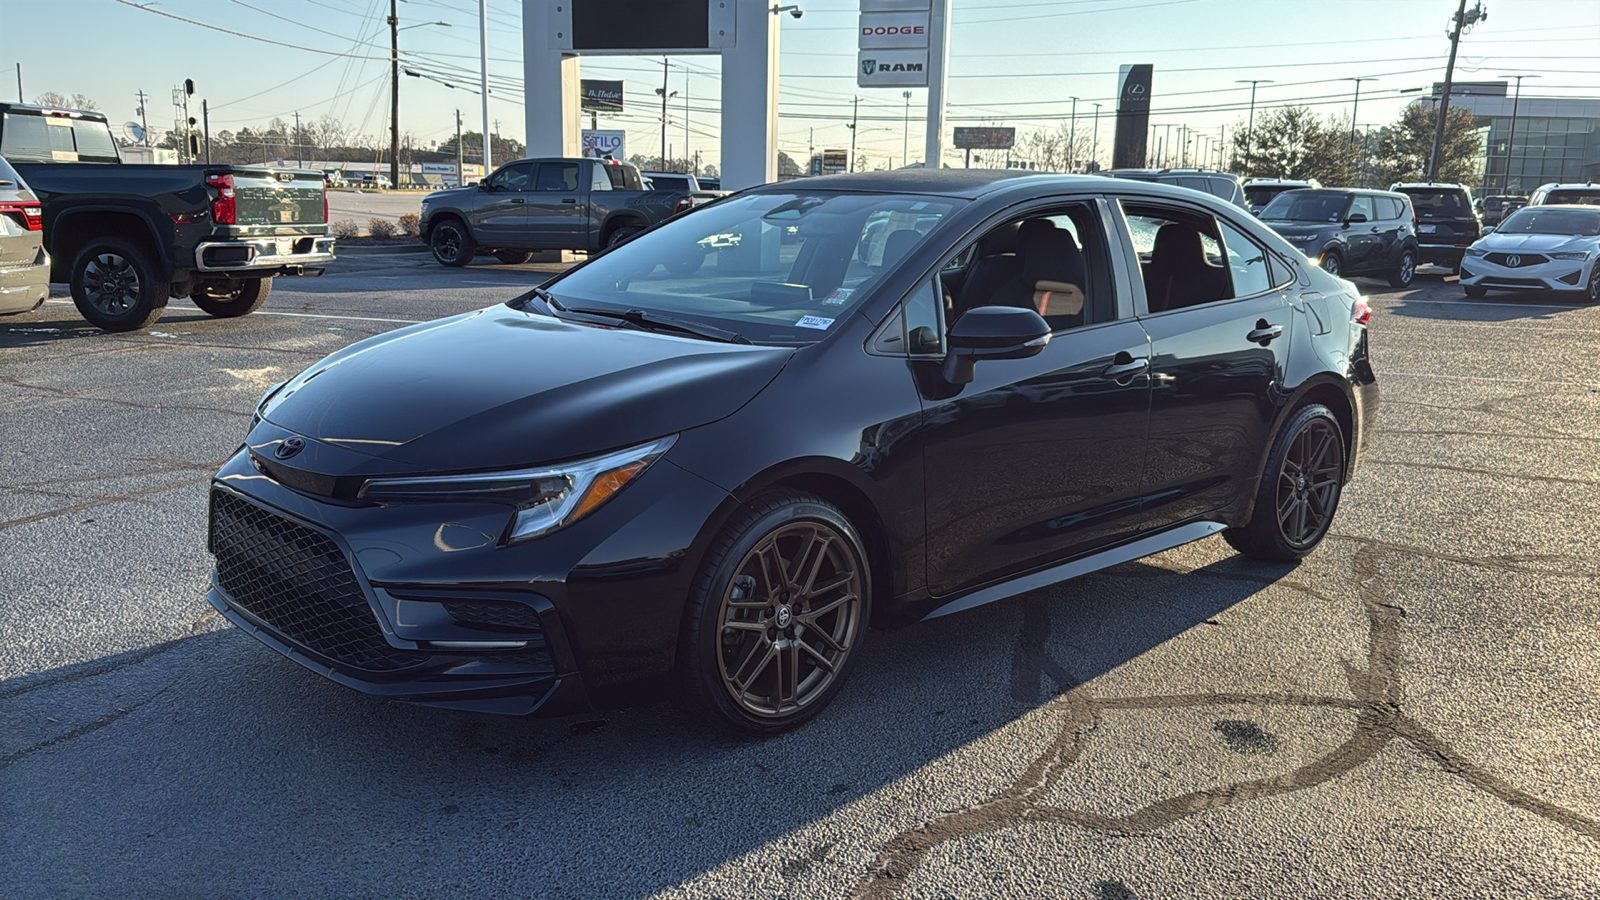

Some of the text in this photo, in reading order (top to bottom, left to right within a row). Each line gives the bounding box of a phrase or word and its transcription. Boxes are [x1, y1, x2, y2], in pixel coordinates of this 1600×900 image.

[862, 26, 925, 36] DODGE
[878, 63, 923, 72] RAM
[583, 136, 621, 147] STILO
